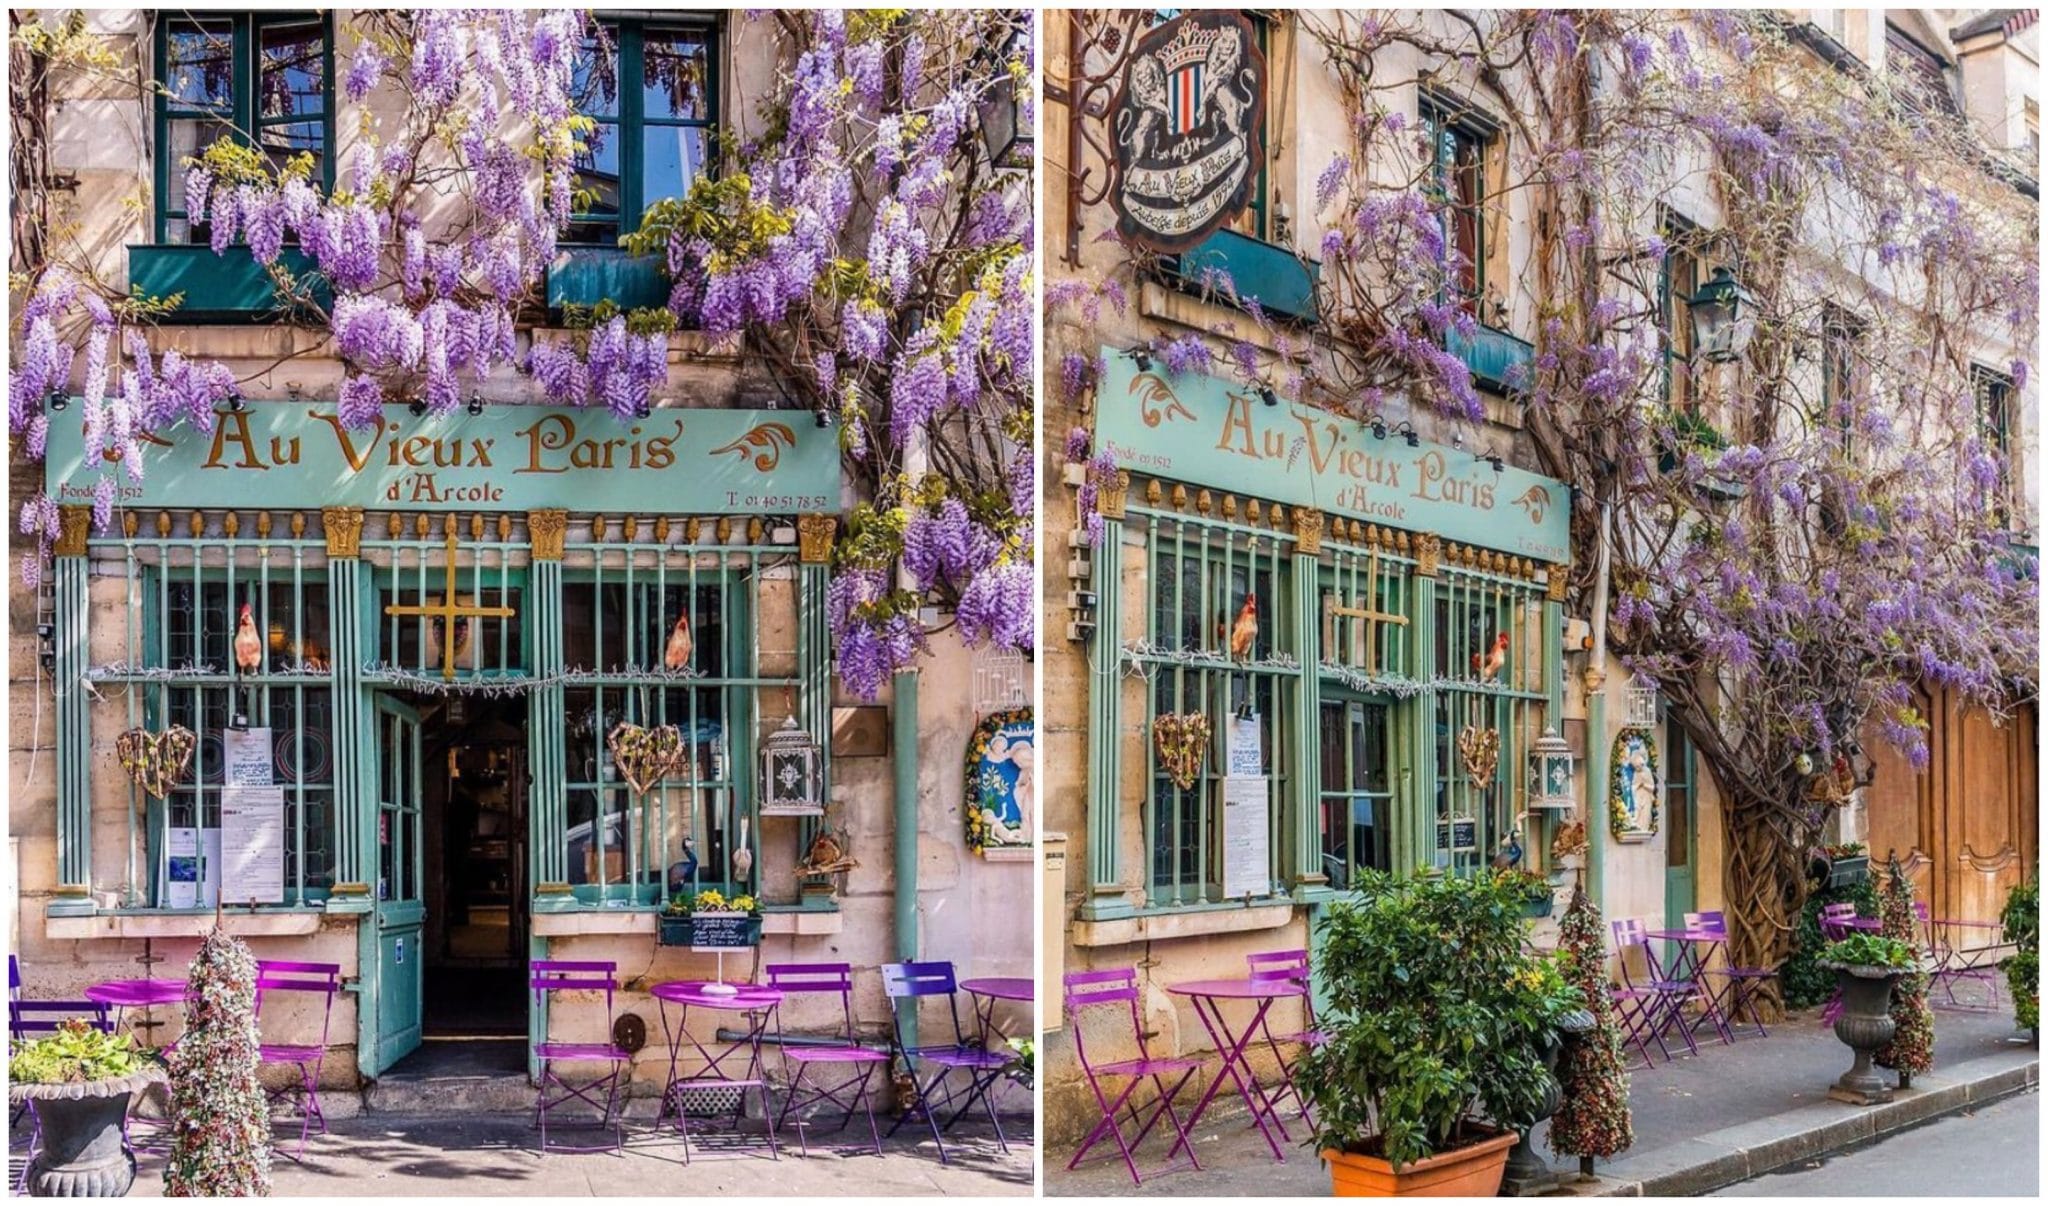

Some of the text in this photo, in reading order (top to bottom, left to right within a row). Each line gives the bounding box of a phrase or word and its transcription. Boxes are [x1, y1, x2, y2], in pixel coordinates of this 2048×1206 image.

[1174, 204, 1210, 229] depuis
[1212, 177, 1236, 210] 1594
[201, 409, 683, 474] Au Vieux Paris
[1215, 391, 1499, 510] Au Vieux Paris
[387, 472, 504, 503] d'Arcole
[745, 496, 758, 506] 01
[762, 496, 778, 509] 40
[781, 496, 793, 508] 51
[797, 496, 811, 509] 78
[814, 496, 827, 509] 52
[1336, 484, 1405, 520] d'Arcole
